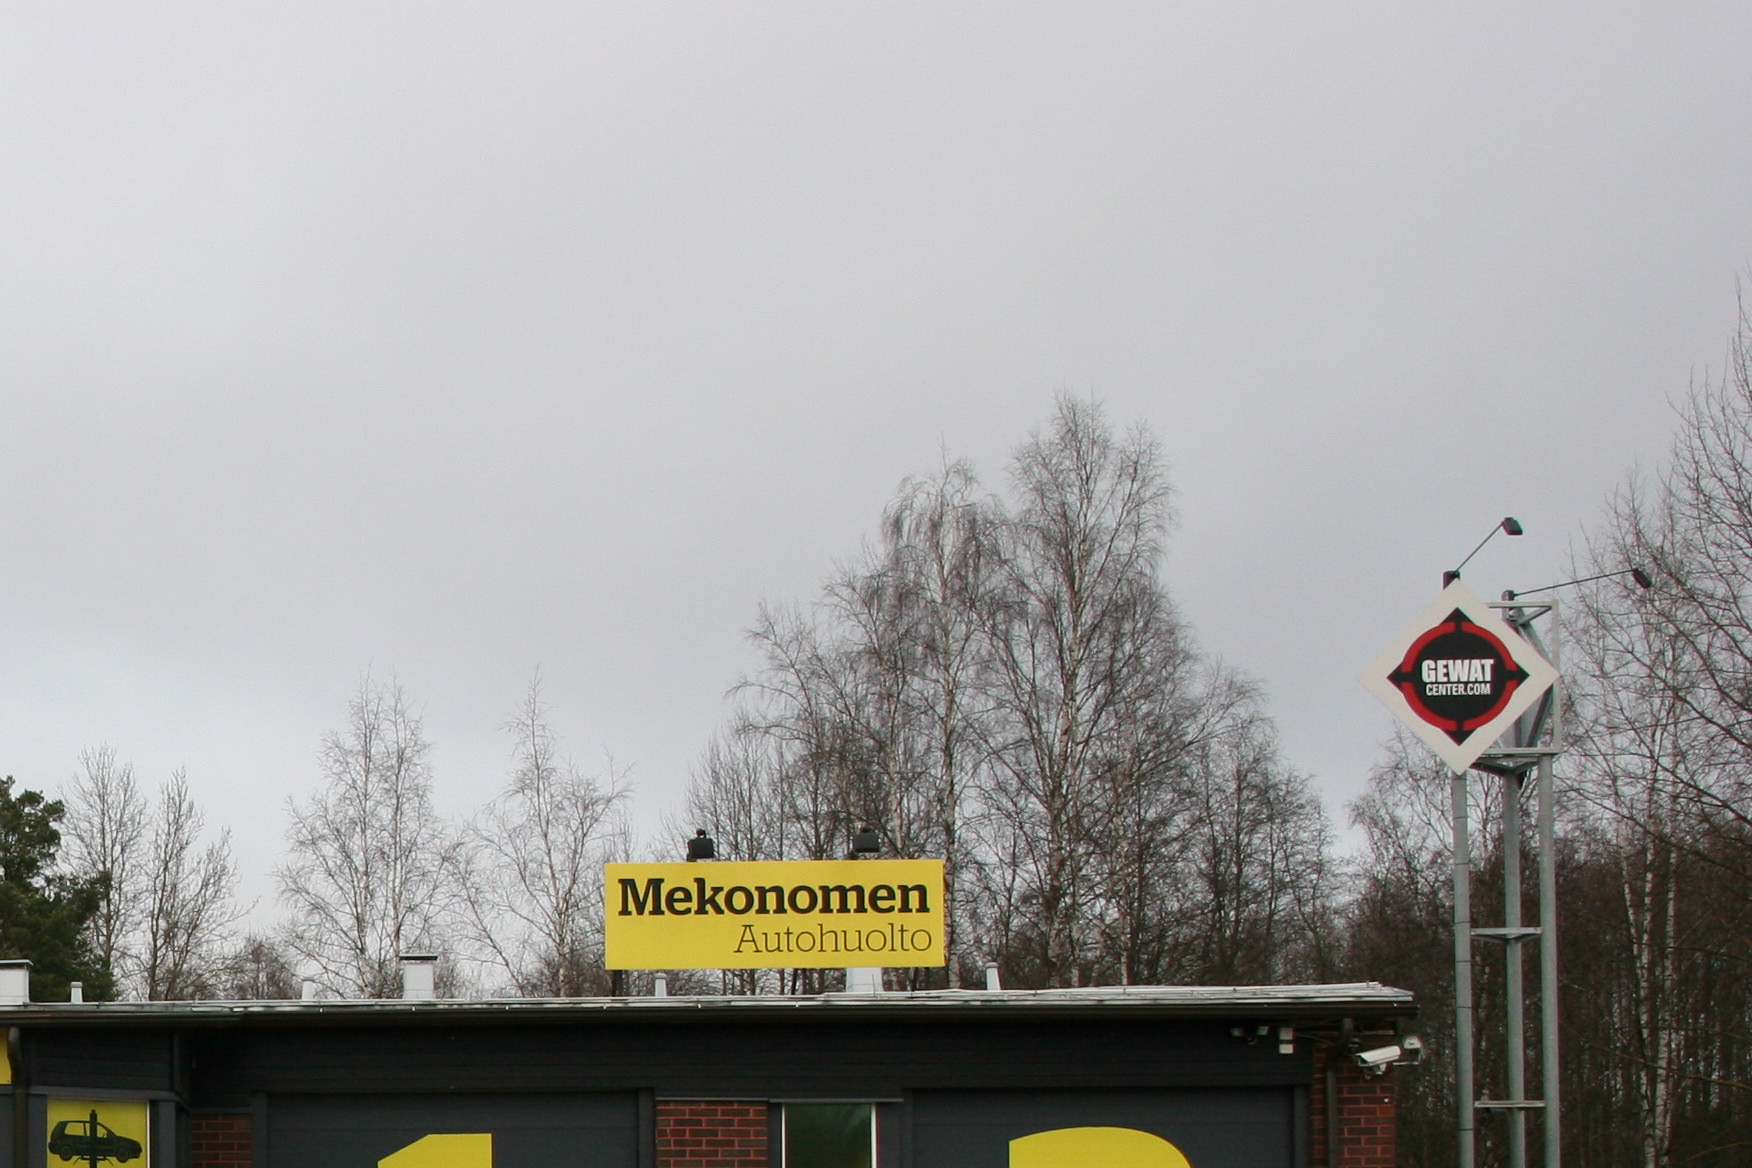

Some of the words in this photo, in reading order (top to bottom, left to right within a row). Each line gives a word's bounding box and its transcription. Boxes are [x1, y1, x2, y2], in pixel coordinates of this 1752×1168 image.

[1421, 659, 1495, 683] GEWAT
[1425, 683, 1491, 696] CENTER.COM
[617, 877, 931, 916] Mekonomen
[733, 923, 933, 953] Autohuolto
